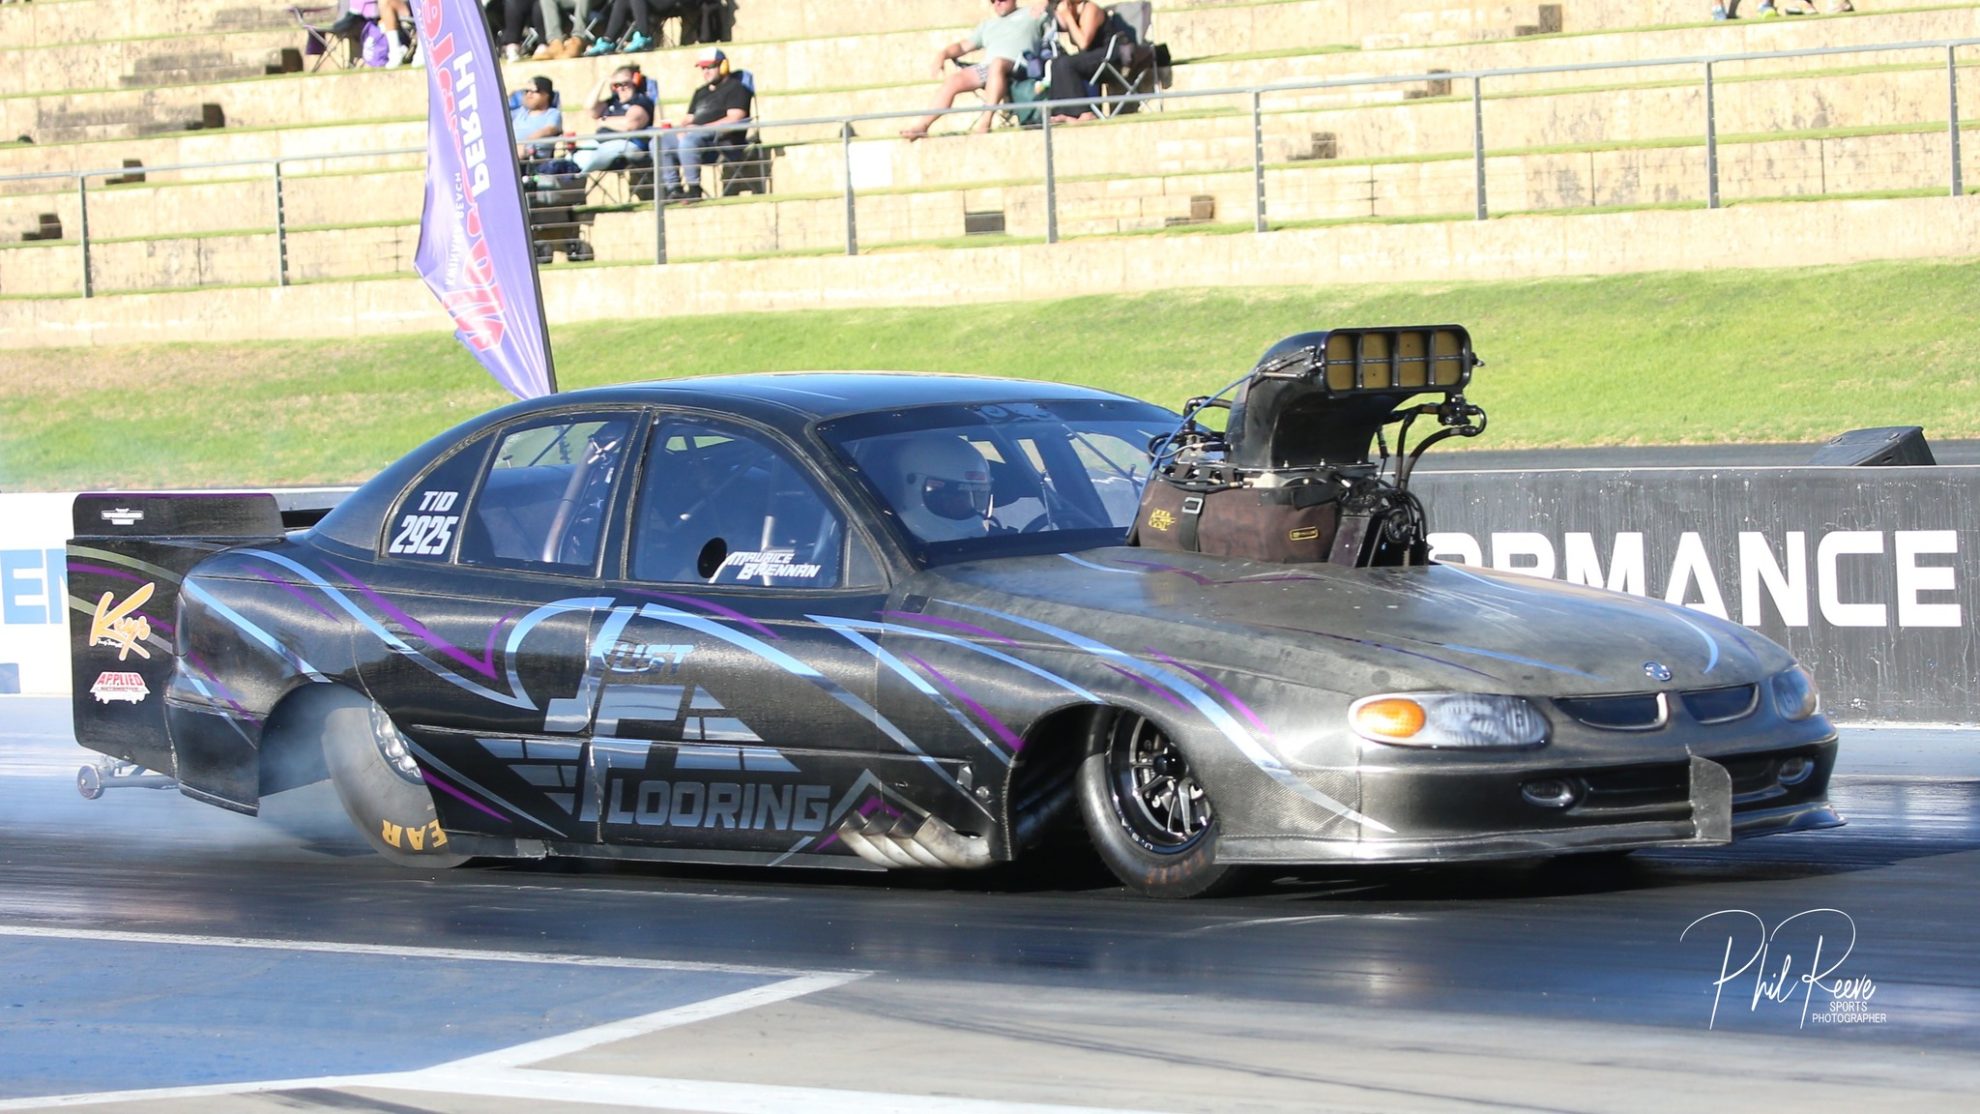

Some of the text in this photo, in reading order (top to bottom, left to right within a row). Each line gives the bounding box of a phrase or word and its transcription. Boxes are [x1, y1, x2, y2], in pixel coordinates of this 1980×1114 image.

[418, 490, 459, 511] TID
[388, 514, 460, 555] 2925
[736, 562, 821, 580] BRENNAN
[97, 673, 144, 686] APPLIED
[382, 818, 448, 850] EAR
